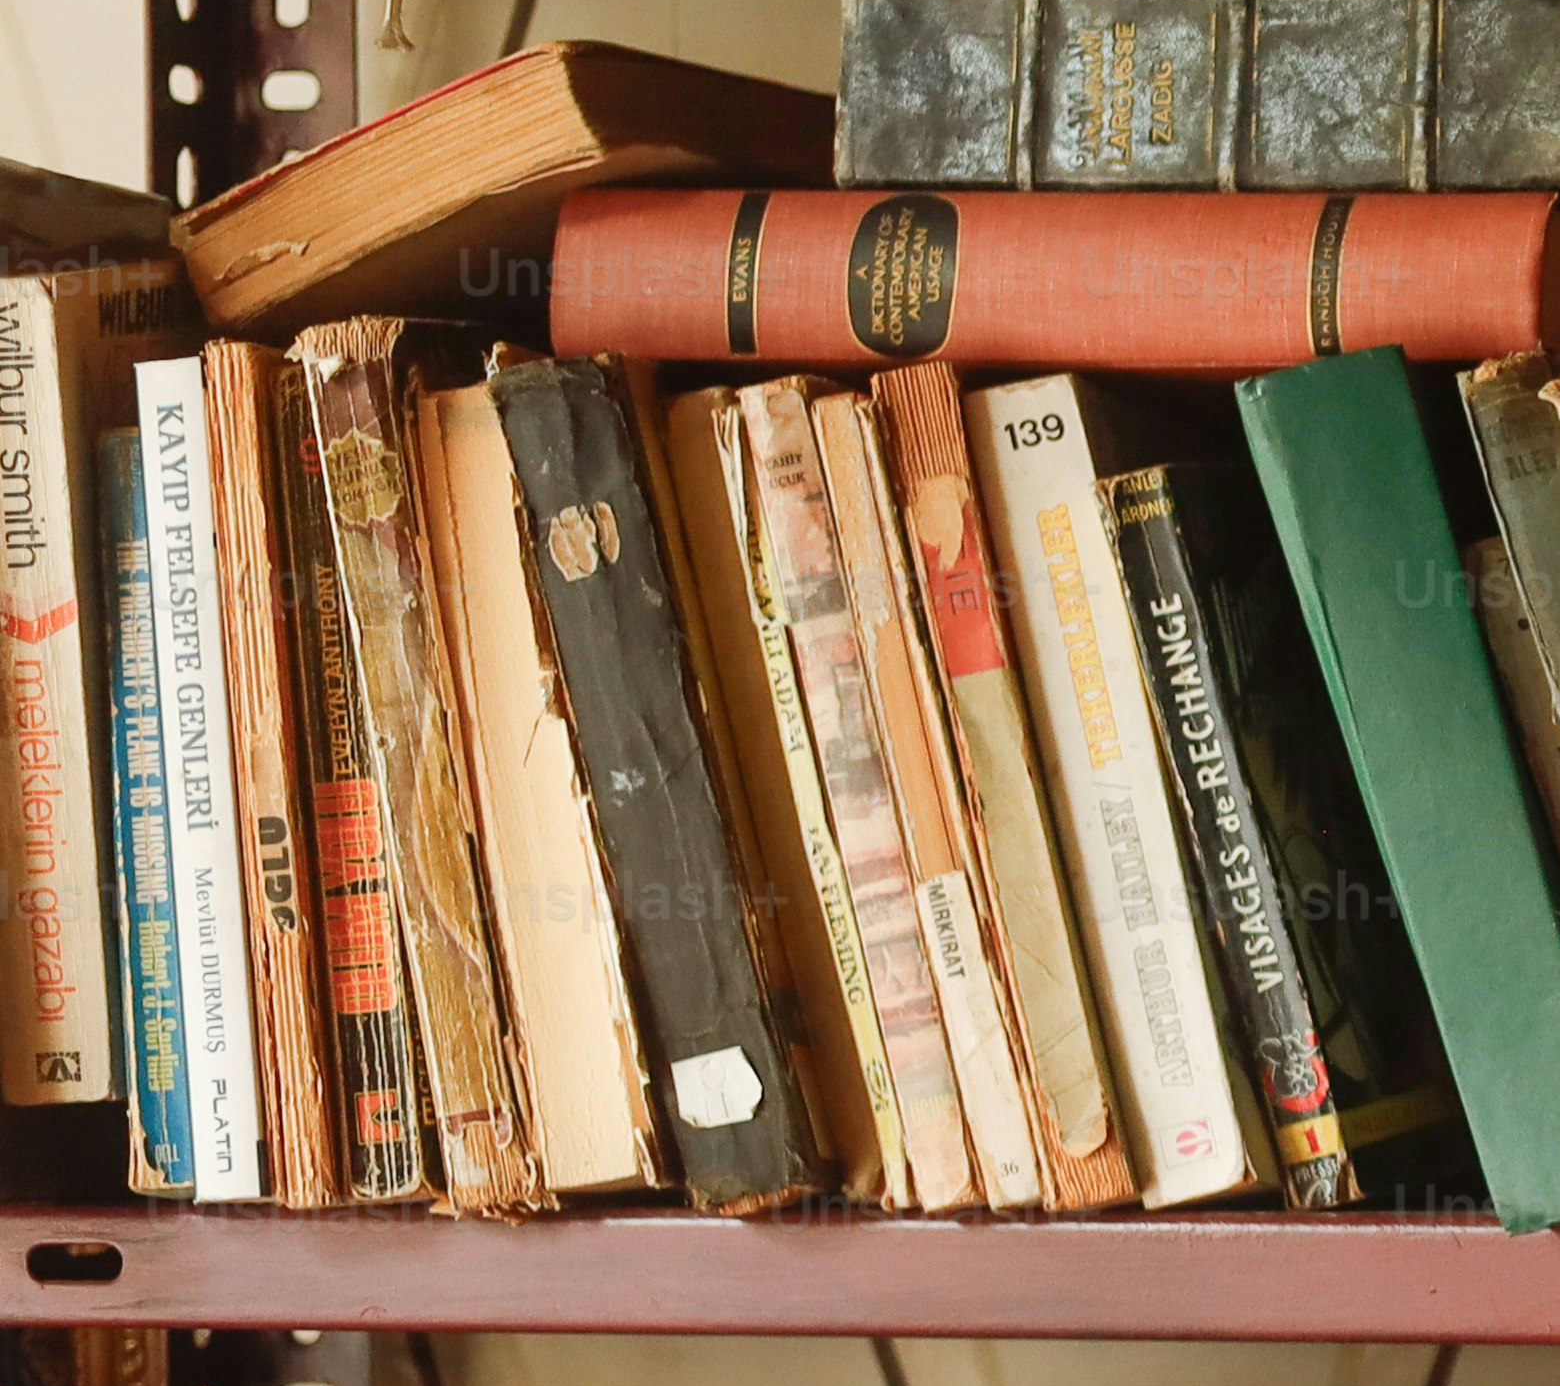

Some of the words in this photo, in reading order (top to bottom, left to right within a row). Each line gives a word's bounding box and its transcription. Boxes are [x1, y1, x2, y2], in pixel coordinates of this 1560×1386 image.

[733, 236, 751, 304] EVANS
[889, 205, 915, 346] CONTEMPORARY
[910, 228, 931, 322] AMERICAN
[927, 246, 944, 307] USAGE
[158, 402, 191, 512] KAYIP
[1003, 414, 1066, 451] 139
[165, 522, 202, 675] FELSEFE
[1035, 502, 1124, 768] TEKERLEKLER
[178, 685, 219, 833] GENLERİ
[1149, 592, 1230, 802] RECHANGE
[16, 661, 64, 859] meleklerin
[1212, 794, 1243, 836] de
[26, 869, 76, 1022] gazabı
[195, 867, 214, 942] Mevlüt
[1229, 843, 1284, 994] VISAGES
[202, 945, 226, 1052] DURMUŞ
